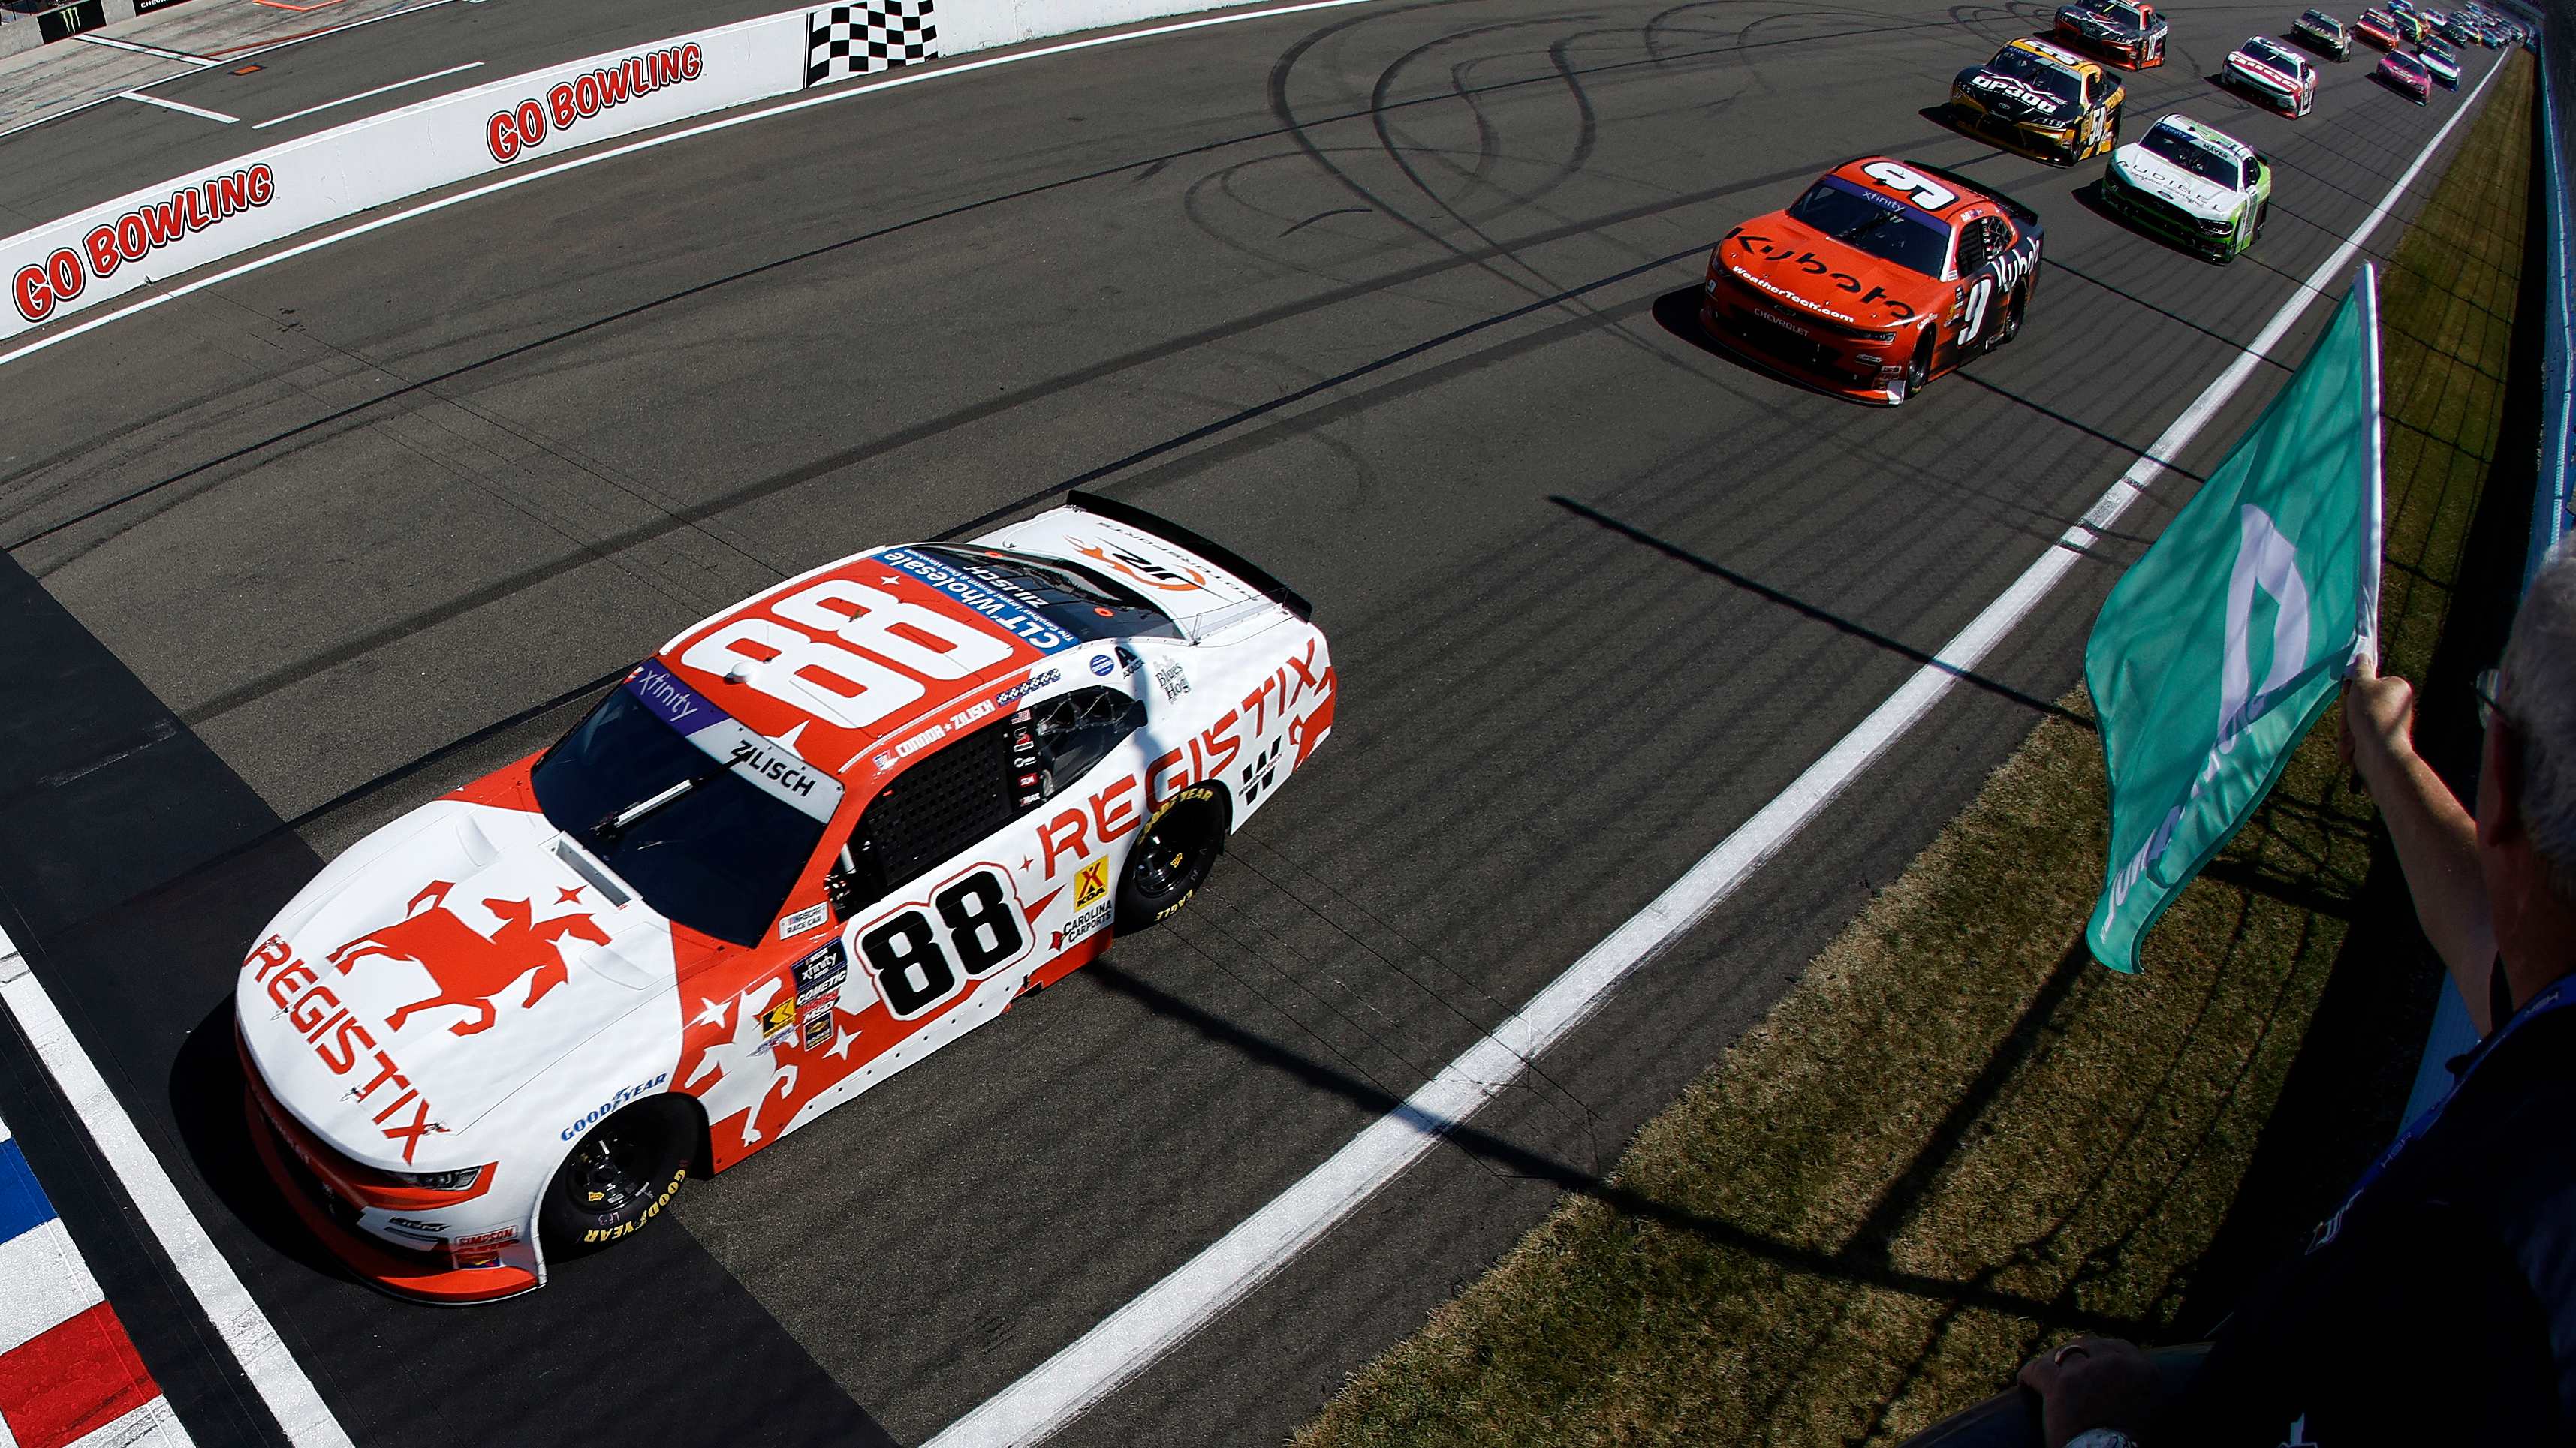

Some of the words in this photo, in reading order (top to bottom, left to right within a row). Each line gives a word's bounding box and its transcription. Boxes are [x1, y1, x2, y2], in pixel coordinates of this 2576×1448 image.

[487, 99, 547, 164] GO
[547, 42, 703, 130] BOWLING
[2202, 143, 2228, 159] MAYER
[1862, 161, 1957, 211] 9
[1862, 190, 1906, 212] xfinity
[2116, 160, 2223, 212] AUDIBEL
[13, 247, 86, 323] GO
[83, 164, 274, 278] BOWLING
[1707, 279, 1717, 293] 9
[1725, 227, 1915, 328] Kubota
[1733, 265, 1854, 323] WeatherTech.com
[1754, 308, 1810, 336] CHEVROLET
[1957, 278, 1992, 345] 9
[941, 566, 963, 577] Dent
[1097, 522, 1258, 601] MOTORSPORTS
[884, 552, 1005, 616] Wholesale
[963, 566, 1050, 609] ZILISCH
[967, 578, 996, 595] Scratch
[993, 593, 1023, 612] Largest
[1057, 630, 1075, 643] The
[680, 580, 1014, 730] 88
[1155, 662, 1183, 689] Blues
[1164, 677, 1192, 701] Hog
[638, 668, 699, 724] xfinity
[949, 699, 996, 730] ZILISCH
[729, 738, 818, 798] ZILISCH
[1036, 637, 1322, 881] REGISTIX
[1077, 887, 1106, 908] KOA
[1154, 889, 1193, 922] EAGLE
[786, 920, 807, 935] RACE
[806, 914, 822, 927] CAR
[1063, 899, 1112, 935] CAROLINA
[1068, 913, 1112, 943] CARPORTS
[860, 870, 1024, 1016] 88
[801, 952, 838, 981] xfinity
[797, 969, 847, 1007] COMETIC
[803, 1000, 835, 1024] MSD
[242, 933, 451, 1167] REGISTIX
[561, 1073, 667, 1142] GOODYEAR
[584, 1169, 686, 1242] GOODYEAR
[598, 1211, 621, 1225] LF-3
[458, 1227, 514, 1247] SIMPSON
